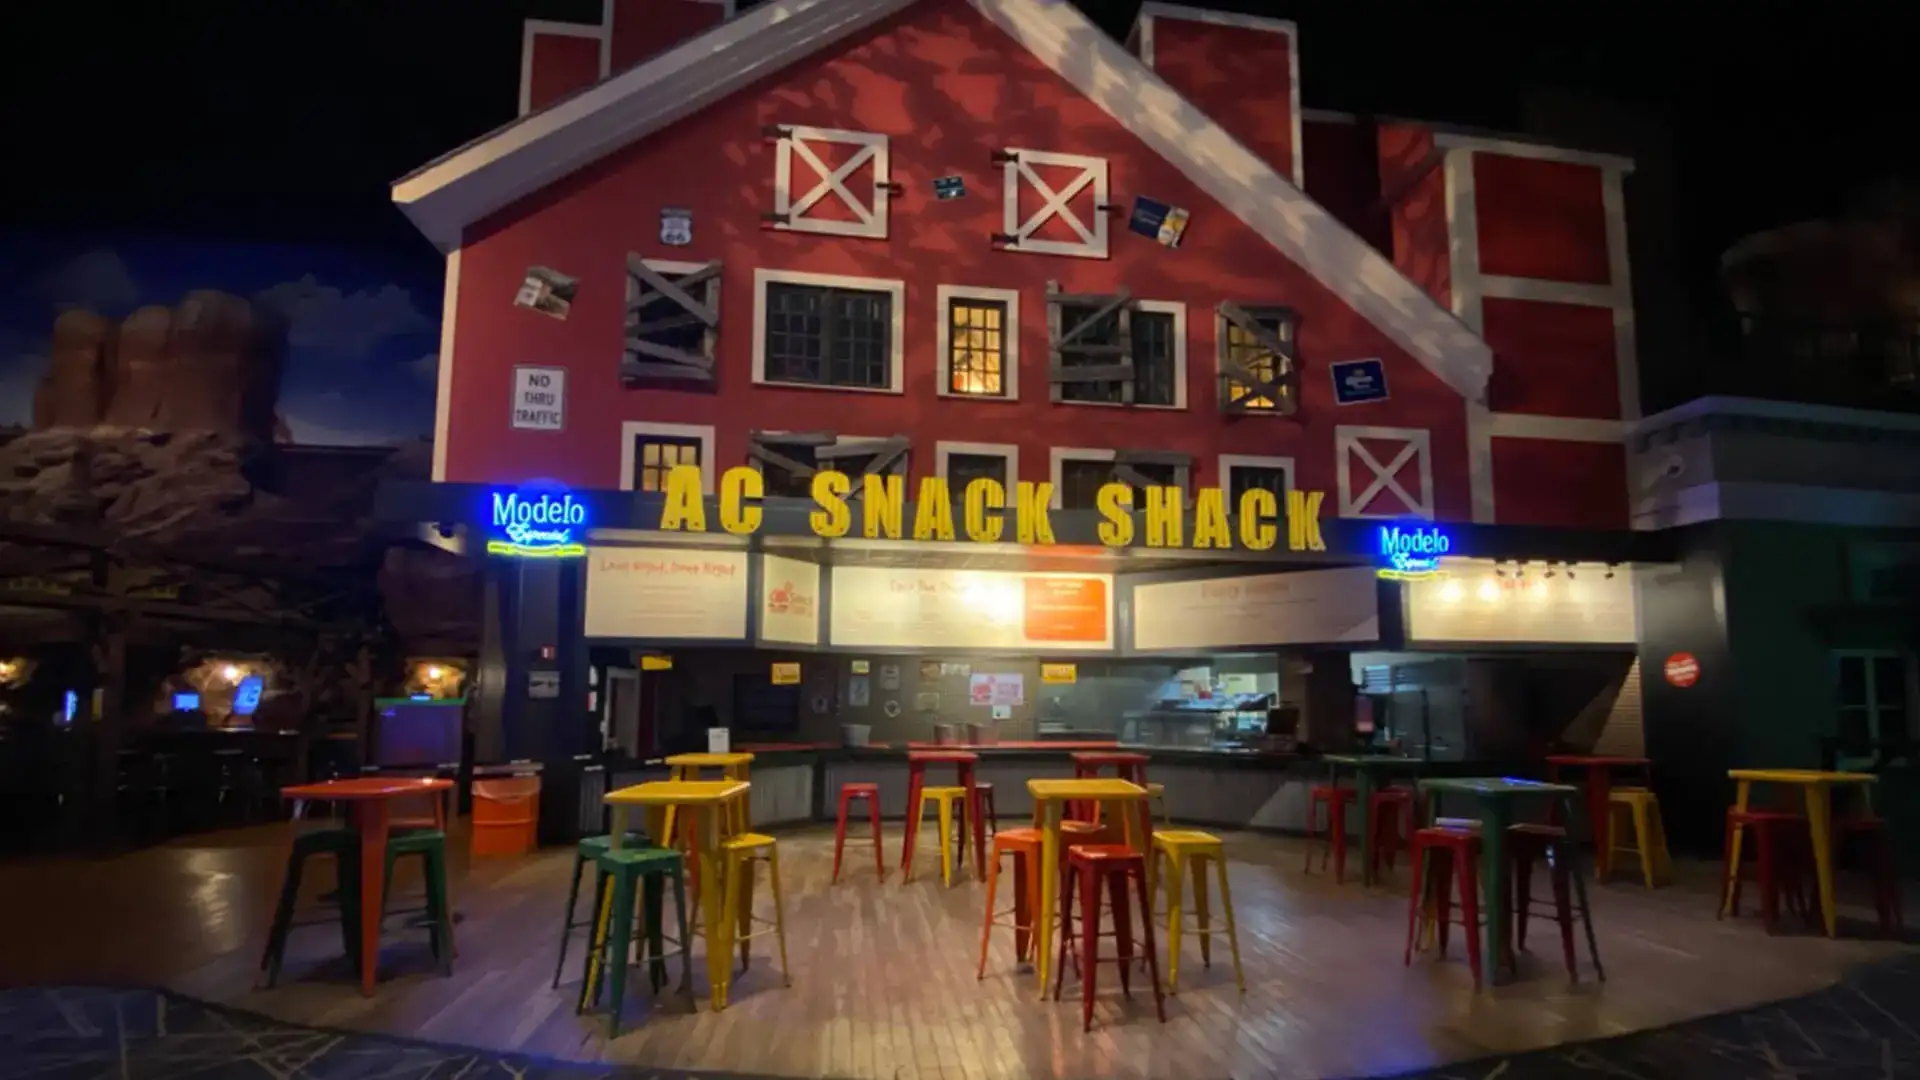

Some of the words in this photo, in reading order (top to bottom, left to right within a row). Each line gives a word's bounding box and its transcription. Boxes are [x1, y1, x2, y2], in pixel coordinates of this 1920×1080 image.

[528, 374, 551, 388] NO
[525, 391, 556, 406] THRU
[516, 409, 560, 425] TRAFFIC
[492, 491, 585, 526] Modelo
[660, 464, 763, 534] AC
[809, 470, 1056, 544] SNACK
[1096, 482, 1327, 551] SHACK
[1380, 526, 1450, 556] Modelo
